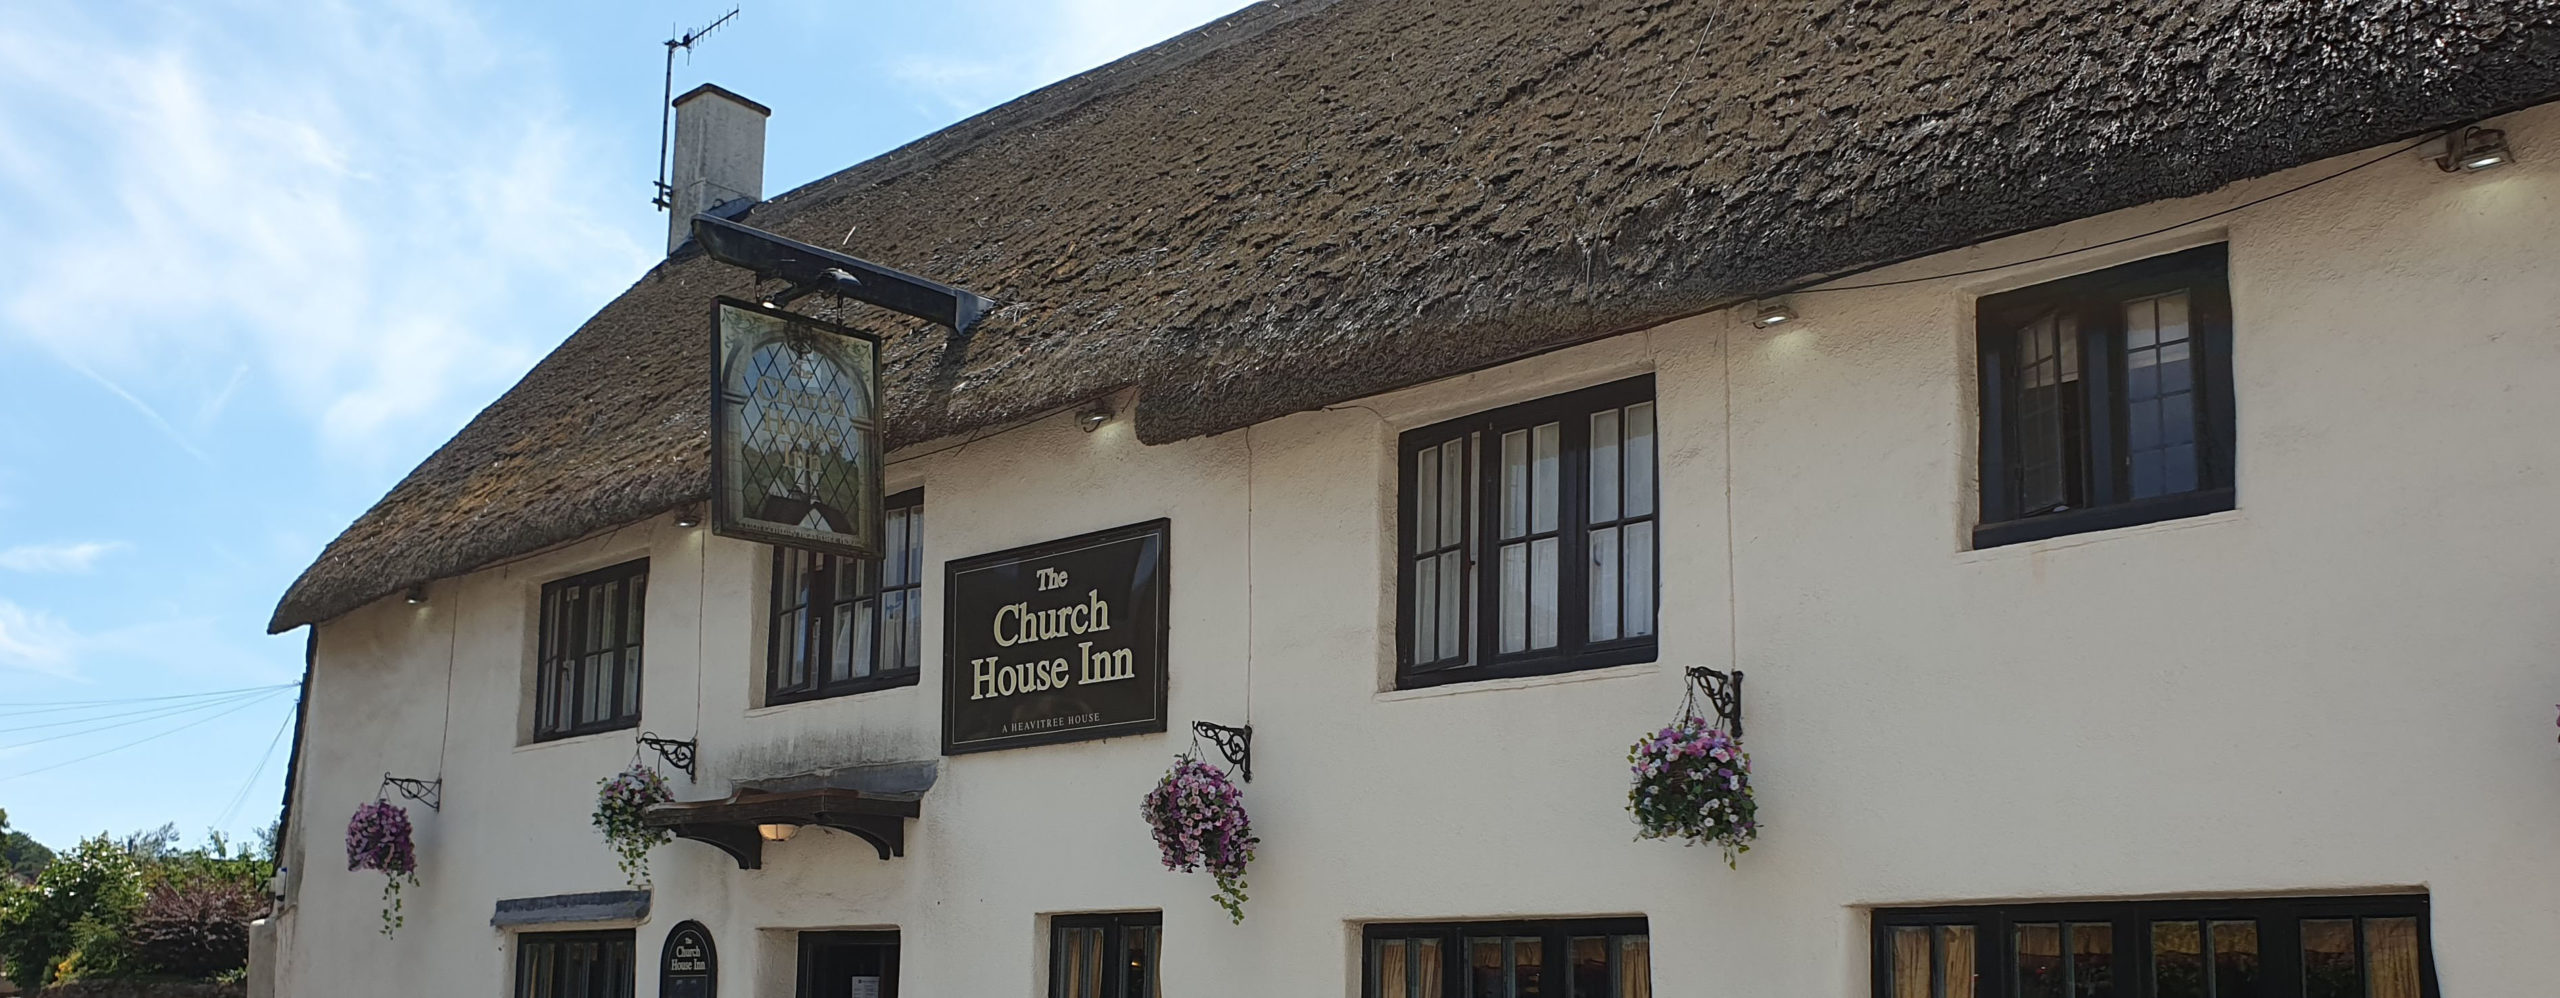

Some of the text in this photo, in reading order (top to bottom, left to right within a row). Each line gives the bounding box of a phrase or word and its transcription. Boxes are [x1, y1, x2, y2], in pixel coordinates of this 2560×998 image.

[757, 375, 846, 417] Church
[763, 405, 840, 448] House
[782, 440, 823, 474] Inn
[1036, 567, 1069, 592] The
[993, 588, 1111, 647] Church
[970, 641, 1136, 701] House Inn
[1002, 712, 1101, 734] A HEAVITREE HOUSE
[671, 958, 706, 971] House Inn
[676, 945, 701, 958] Church
